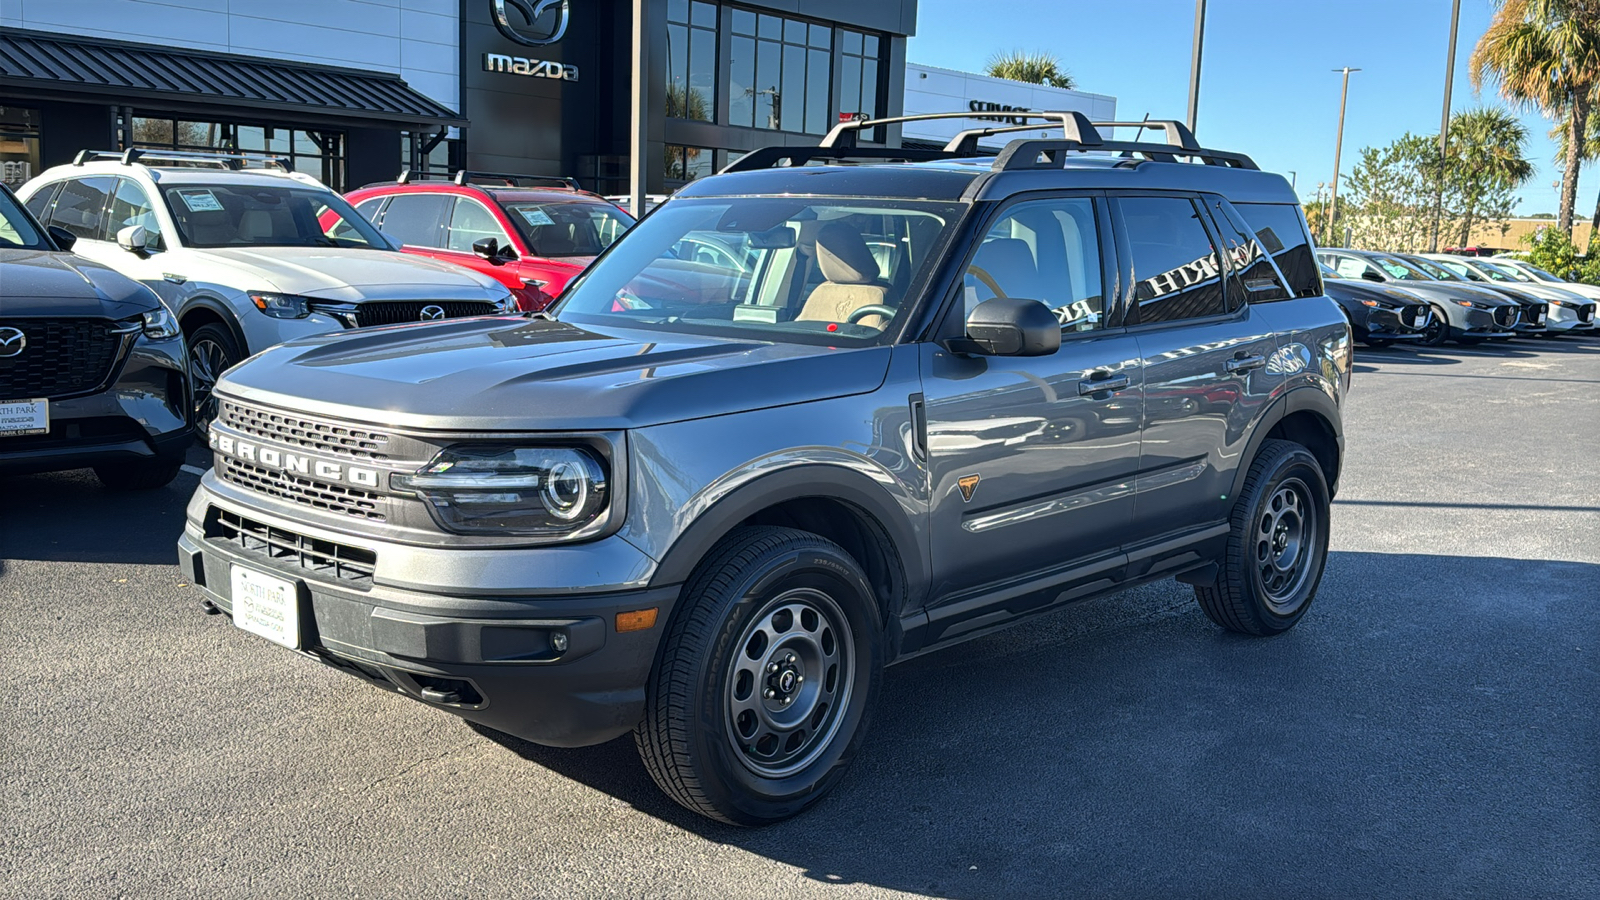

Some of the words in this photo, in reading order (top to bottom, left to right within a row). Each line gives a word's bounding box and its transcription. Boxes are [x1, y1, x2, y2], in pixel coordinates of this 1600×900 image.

[487, 53, 579, 81] mazda
[969, 100, 1031, 126] SERVICE
[16, 406, 37, 414] PARK
[219, 435, 379, 487] BRONCO
[241, 581, 265, 599] NORTH
[267, 589, 286, 606] PARK
